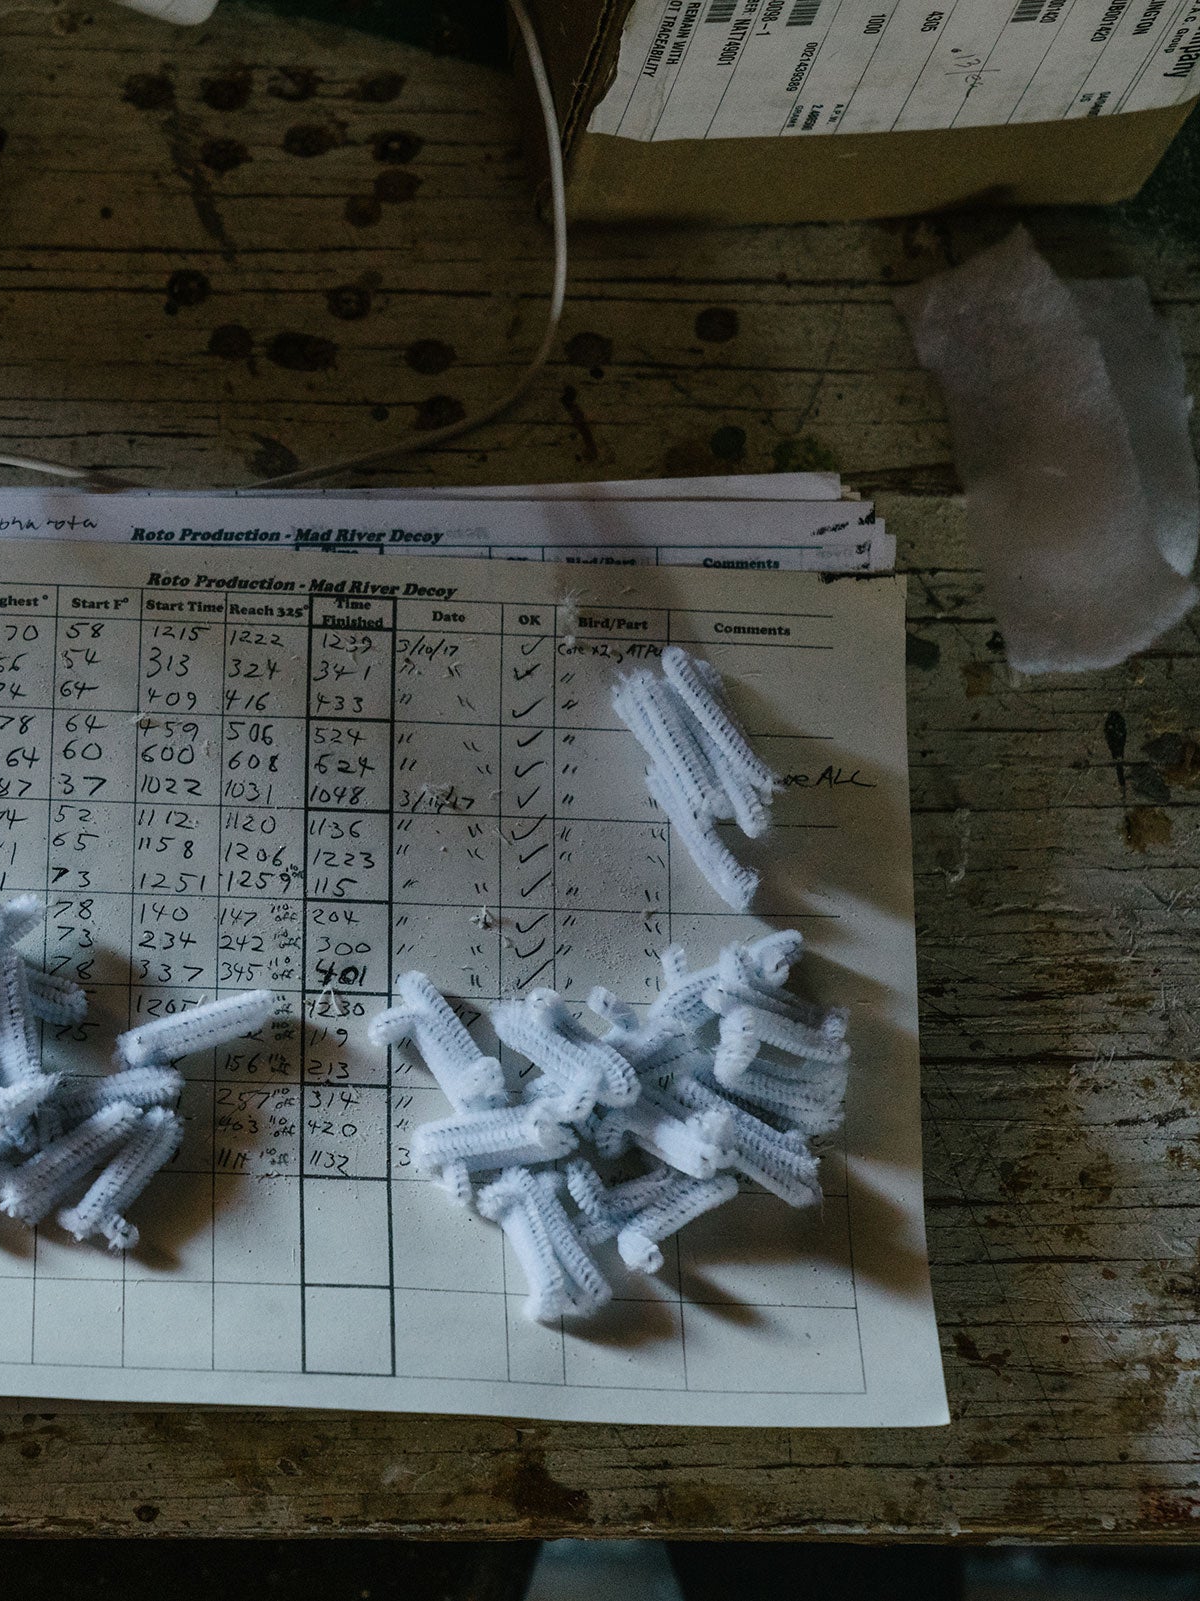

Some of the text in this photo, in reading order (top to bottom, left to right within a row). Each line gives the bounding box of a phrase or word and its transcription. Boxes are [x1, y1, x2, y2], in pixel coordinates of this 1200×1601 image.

[863, 13, 887, 35] 1000
[920, 10, 945, 33] 4305
[1132, 0, 1166, 36] INGTON
[642, 15, 677, 78] TRACEABILITY
[665, 2, 701, 65] REMAIN WITH
[716, 18, 752, 67] NAT749001
[1164, 28, 1190, 54] Group
[785, 42, 818, 92] 0021439389
[131, 527, 444, 546] Roto Production Mad River Decoy
[147, 571, 458, 600] Roto Production Mad River Decoy
[71, 597, 110, 610] Start
[145, 599, 224, 614] Start Time
[229, 604, 274, 617] Reach
[335, 598, 372, 611] Time
[431, 610, 467, 623] Date
[322, 615, 384, 629] Finished
[518, 613, 541, 627] OK
[577, 617, 649, 631] Bird/Part
[713, 622, 791, 637] Comments
[66, 622, 105, 640] 58
[152, 625, 211, 642] 1215
[228, 630, 284, 648] 1222
[395, 635, 460, 661] 3/10/17
[62, 648, 101, 669] 54
[146, 647, 191, 678] 313
[227, 659, 280, 679] 324
[313, 660, 372, 681] 341
[59, 680, 100, 699] 64
[147, 687, 198, 710] 409
[224, 690, 271, 712] 416
[315, 692, 365, 713] 433
[65, 714, 108, 733] 64
[138, 718, 200, 742] 459
[225, 722, 274, 746] 506
[313, 727, 367, 747] 524
[62, 739, 103, 761] 60
[140, 744, 195, 766] 600
[228, 751, 280, 773] 608
[314, 754, 376, 779] 624
[59, 773, 108, 796] 37
[140, 774, 203, 797] 1022
[224, 779, 273, 804] 1031
[309, 785, 366, 804] 1048
[53, 804, 92, 823] 52
[138, 809, 195, 829] 1112
[225, 812, 276, 835] 1120
[310, 818, 361, 840] 1136
[53, 831, 100, 851] 65
[138, 837, 194, 860] 1158
[224, 842, 287, 868] 1206
[313, 848, 376, 870] 1223
[52, 866, 92, 889] 73
[140, 872, 208, 893] 1251
[315, 877, 358, 898] 115
[53, 899, 95, 920] 78
[139, 902, 189, 924] 140
[219, 907, 258, 927] 147
[313, 908, 360, 925] 204
[56, 925, 94, 948] 73
[138, 930, 197, 950] 234
[219, 935, 265, 953] 242
[315, 936, 372, 956] 300
[49, 955, 95, 980] 78
[139, 959, 205, 983] 337
[220, 961, 264, 983] 345
[54, 1022, 349, 1047] 75 119
[224, 1053, 351, 1079] 156 213
[309, 1090, 360, 1109] 314
[308, 1119, 358, 1138] 420
[309, 1150, 351, 1178] 1132
